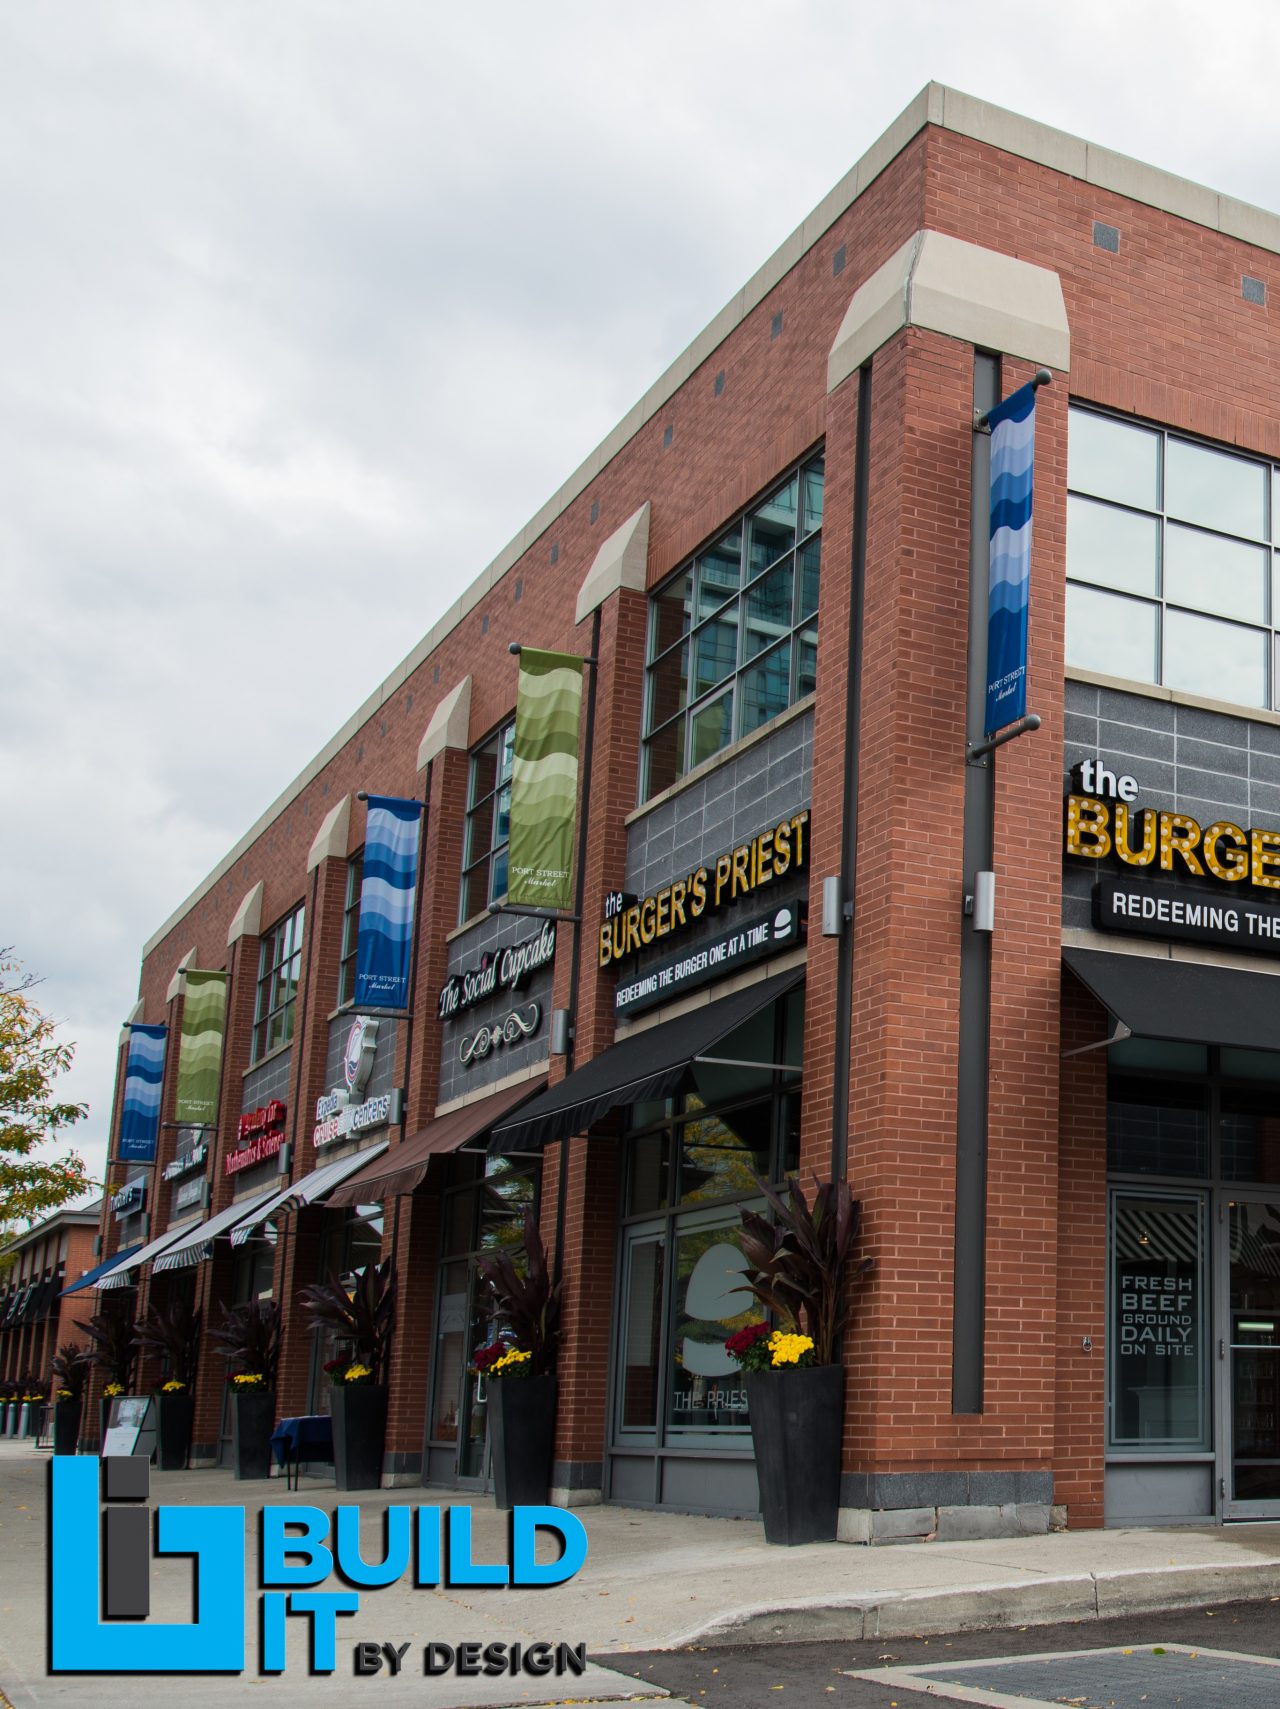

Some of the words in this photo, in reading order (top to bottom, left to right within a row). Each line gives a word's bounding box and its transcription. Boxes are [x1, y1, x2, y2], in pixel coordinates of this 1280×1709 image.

[1003, 666, 1026, 685] STREET
[1080, 759, 1139, 801] the
[512, 866, 534, 875] PORT
[536, 869, 569, 878] STREET
[524, 876, 556, 887] Market
[599, 867, 708, 968] BURGER'S
[715, 810, 809, 906] PRIEST
[605, 891, 623, 919] the
[1112, 892, 1239, 933] REDEEMING
[440, 978, 459, 1016] The
[461, 951, 500, 1005] Social
[501, 921, 555, 989] Cupcake
[616, 975, 657, 1007] REDEEMING
[659, 966, 675, 988] THE
[675, 952, 708, 981] BURGER
[709, 943, 727, 966] ONE
[727, 936, 739, 957] AT
[739, 933, 746, 951] A
[747, 922, 769, 950] TIME
[359, 973, 378, 981] PORT
[379, 975, 406, 983] STREET
[1122, 1275, 1192, 1291] FRESH
[1122, 1293, 1192, 1311] BEEF
[1122, 1313, 1192, 1325] GROUND
[1121, 1325, 1192, 1343] DAILY
[1120, 1344, 1146, 1355] ON
[1155, 1344, 1194, 1356] SITE
[674, 1391, 700, 1409] THE
[707, 1390, 748, 1409] PRIES
